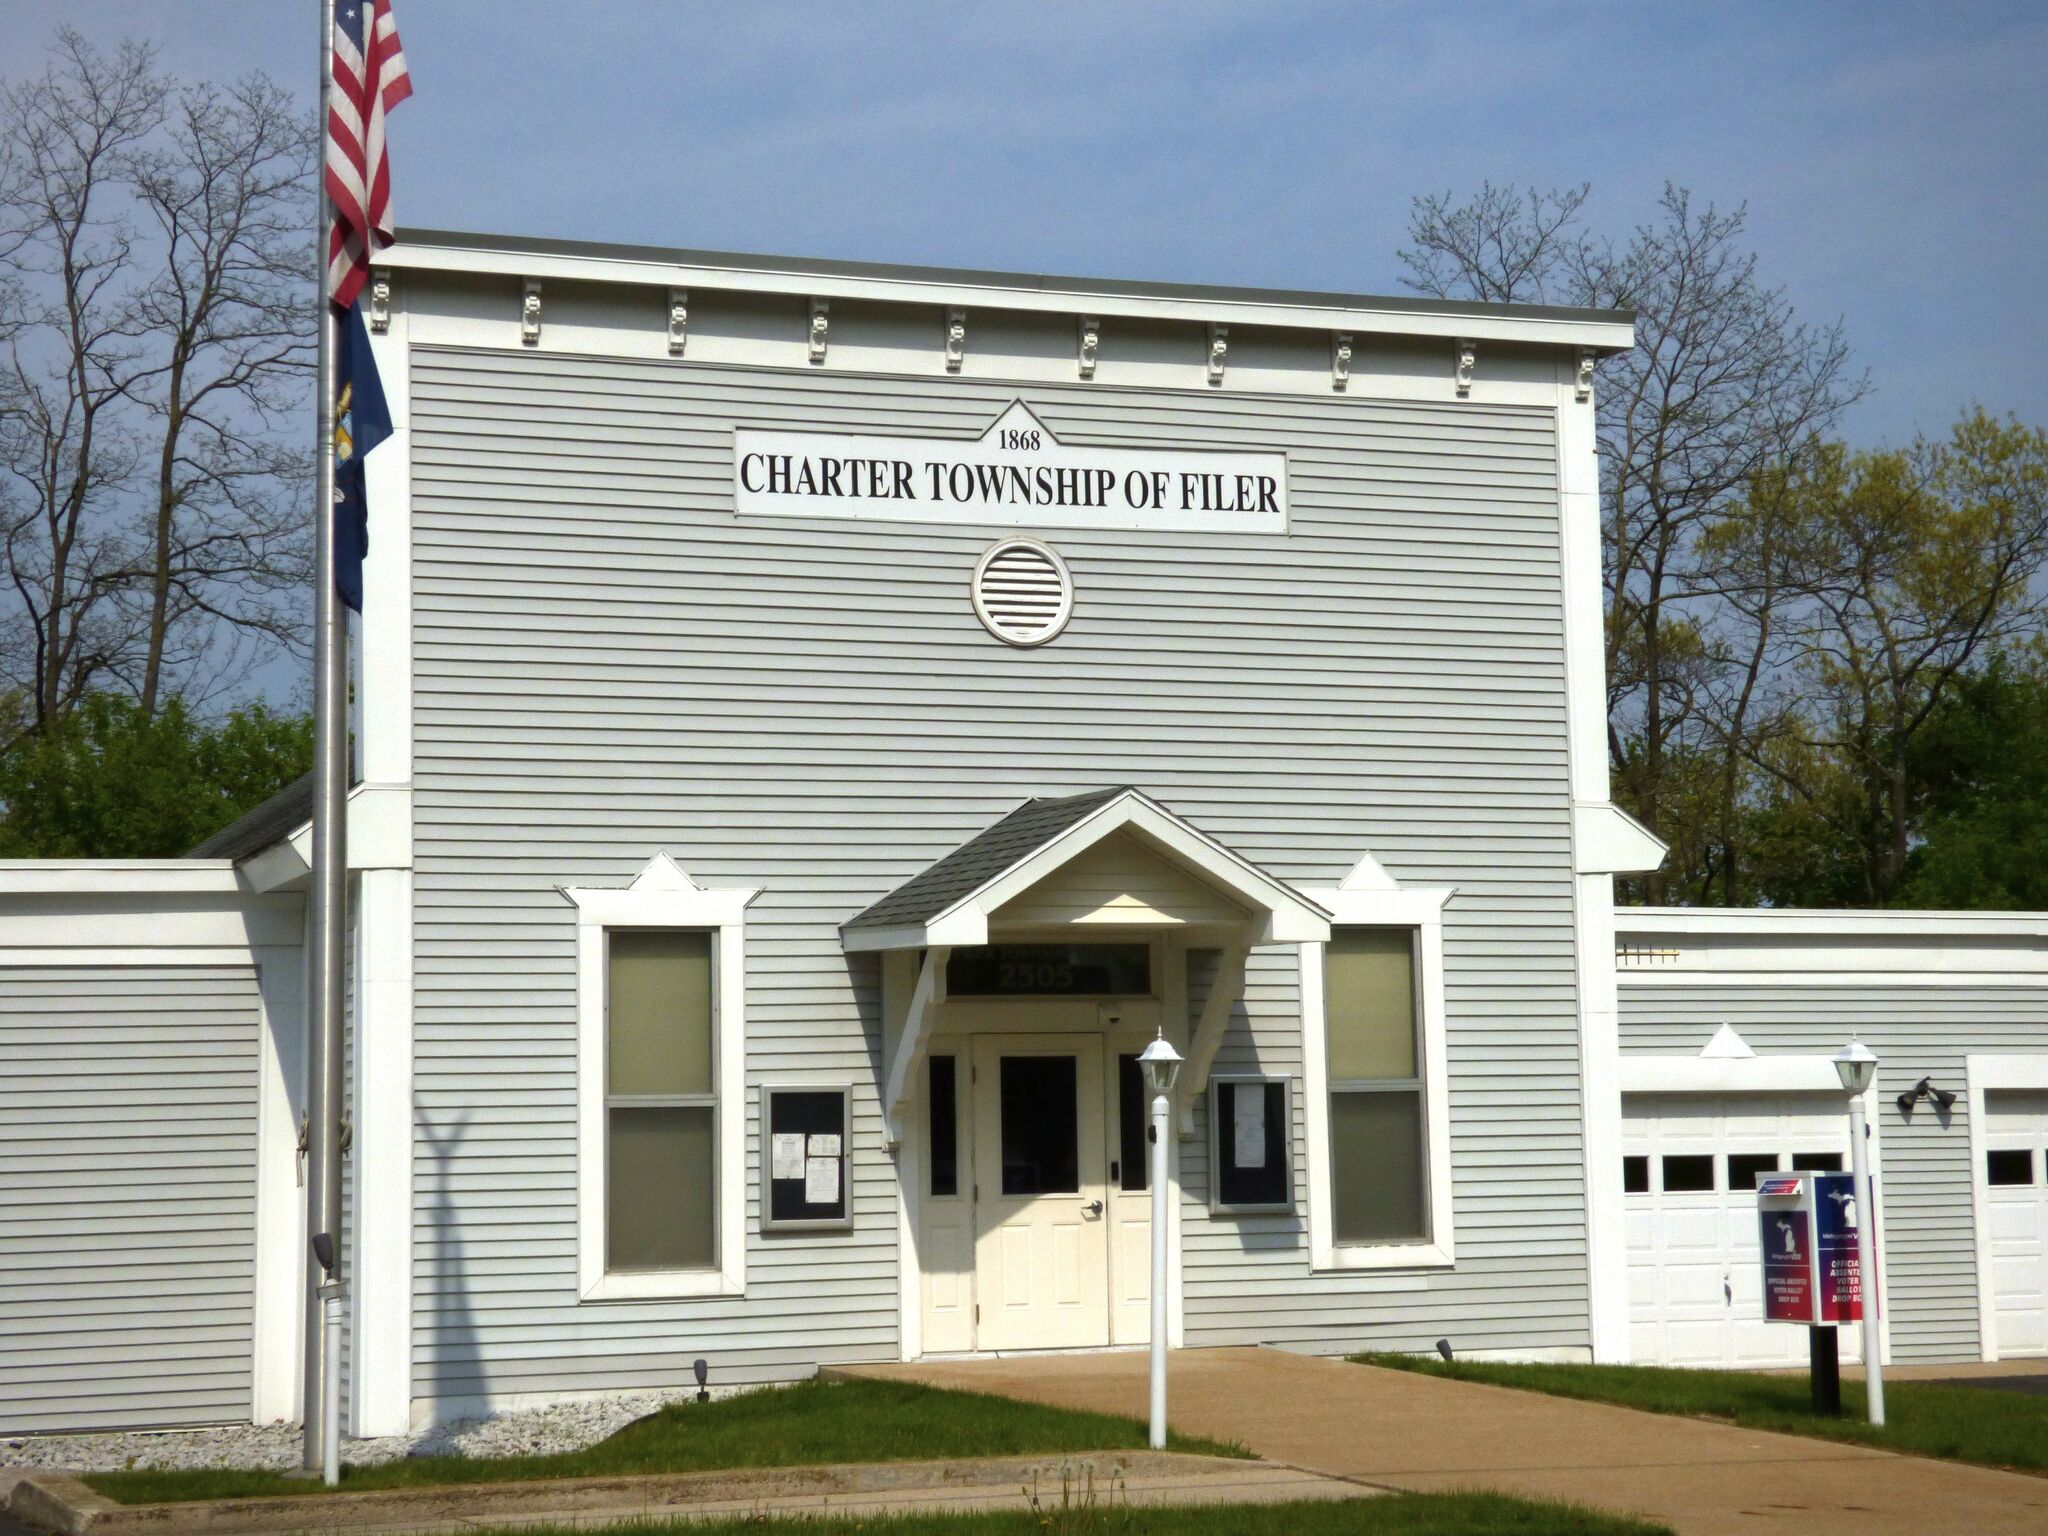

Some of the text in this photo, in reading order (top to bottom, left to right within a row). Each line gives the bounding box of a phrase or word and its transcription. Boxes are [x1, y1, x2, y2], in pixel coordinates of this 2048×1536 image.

[999, 429, 1041, 451] 1868
[740, 453, 1280, 513] CHARTER TOWNSHIP OF FILER
[998, 963, 1074, 988] 2505
[1831, 1260, 1859, 1268] OFFICIA
[1830, 1268, 1861, 1277] ABSENTE
[1837, 1277, 1859, 1285] VOTER
[1832, 1294, 1852, 1303] DROP
